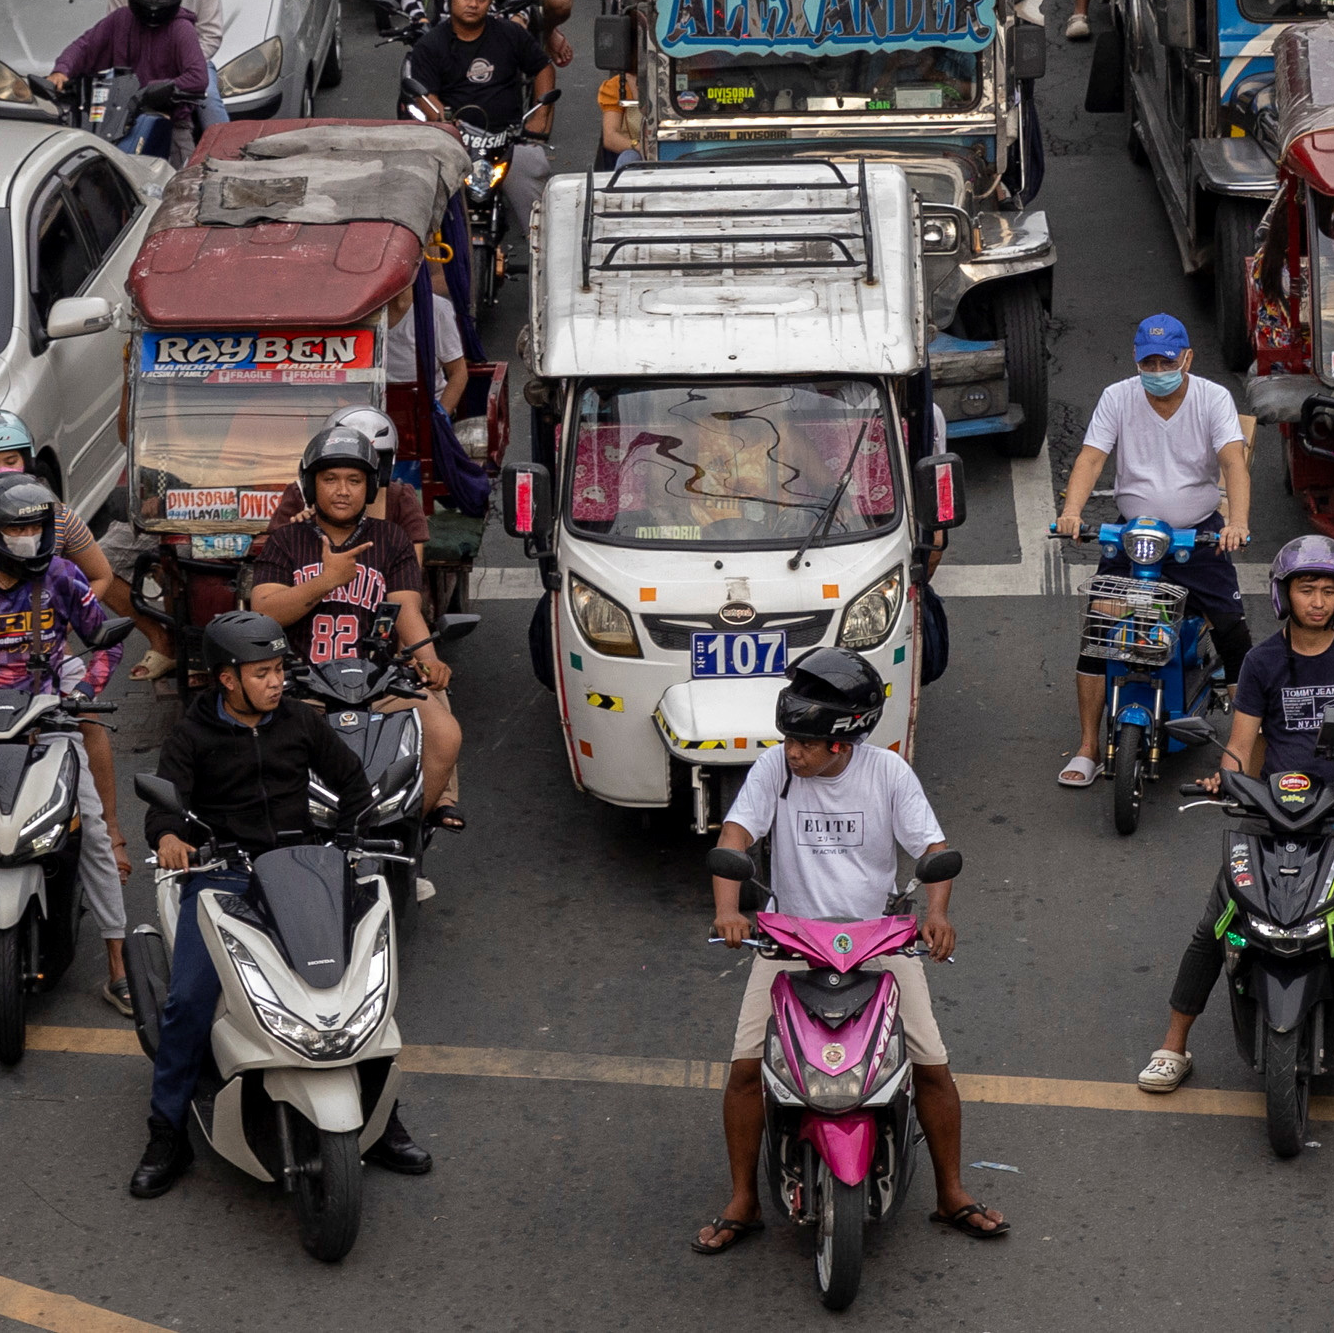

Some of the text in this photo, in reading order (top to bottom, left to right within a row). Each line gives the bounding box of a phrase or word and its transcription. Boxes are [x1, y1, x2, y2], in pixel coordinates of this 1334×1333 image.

[707, 87, 755, 99] DIVISORIA
[868, 101, 890, 110] SAN
[680, 131, 701, 140] SAN
[736, 130, 788, 140] DIVISORIA
[1149, 328, 1164, 336] USA
[157, 336, 358, 363] RAYBEN
[230, 371, 272, 379] FRAGILE
[294, 371, 336, 379] FRAGILE
[168, 490, 236, 509] DIVISORIA
[310, 614, 359, 664] 82
[707, 634, 782, 674] 107
[1285, 688, 1314, 697] TOMMY
[804, 819, 856, 833] ELITE
